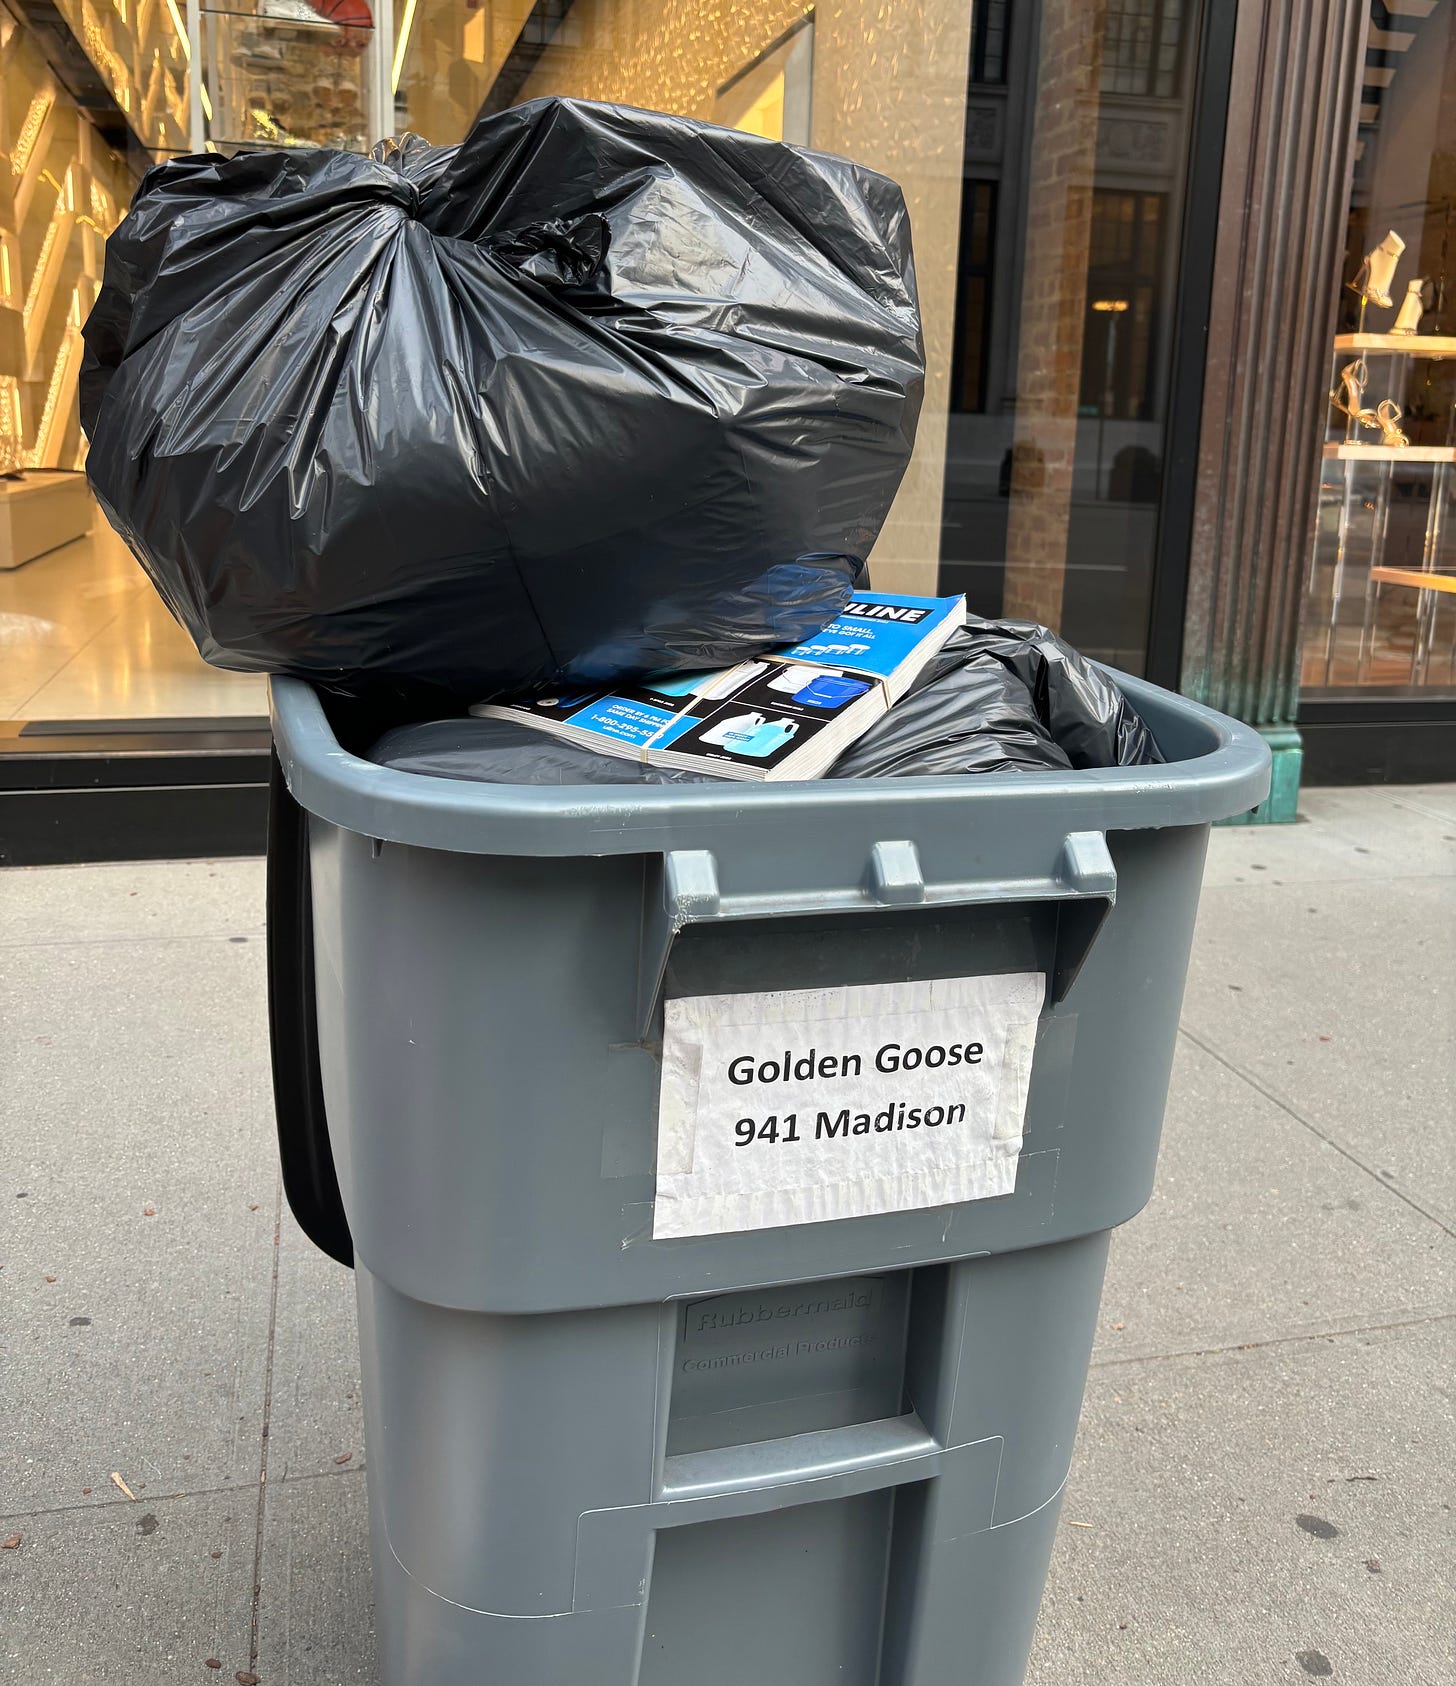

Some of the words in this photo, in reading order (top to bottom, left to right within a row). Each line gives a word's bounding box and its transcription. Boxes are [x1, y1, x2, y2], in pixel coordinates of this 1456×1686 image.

[606, 708, 624, 717] SAME
[625, 713, 640, 721] DAY
[612, 704, 636, 714] ORDER
[591, 714, 664, 739] 1-800-295-550
[602, 725, 637, 739] uline.com
[728, 1049, 862, 1085] Golden
[875, 1041, 984, 1073] Goose
[734, 1113, 801, 1147] 941
[815, 1102, 966, 1140] Madison
[697, 1289, 873, 1331] Rubbermaid
[682, 1343, 790, 1372] Commercial
